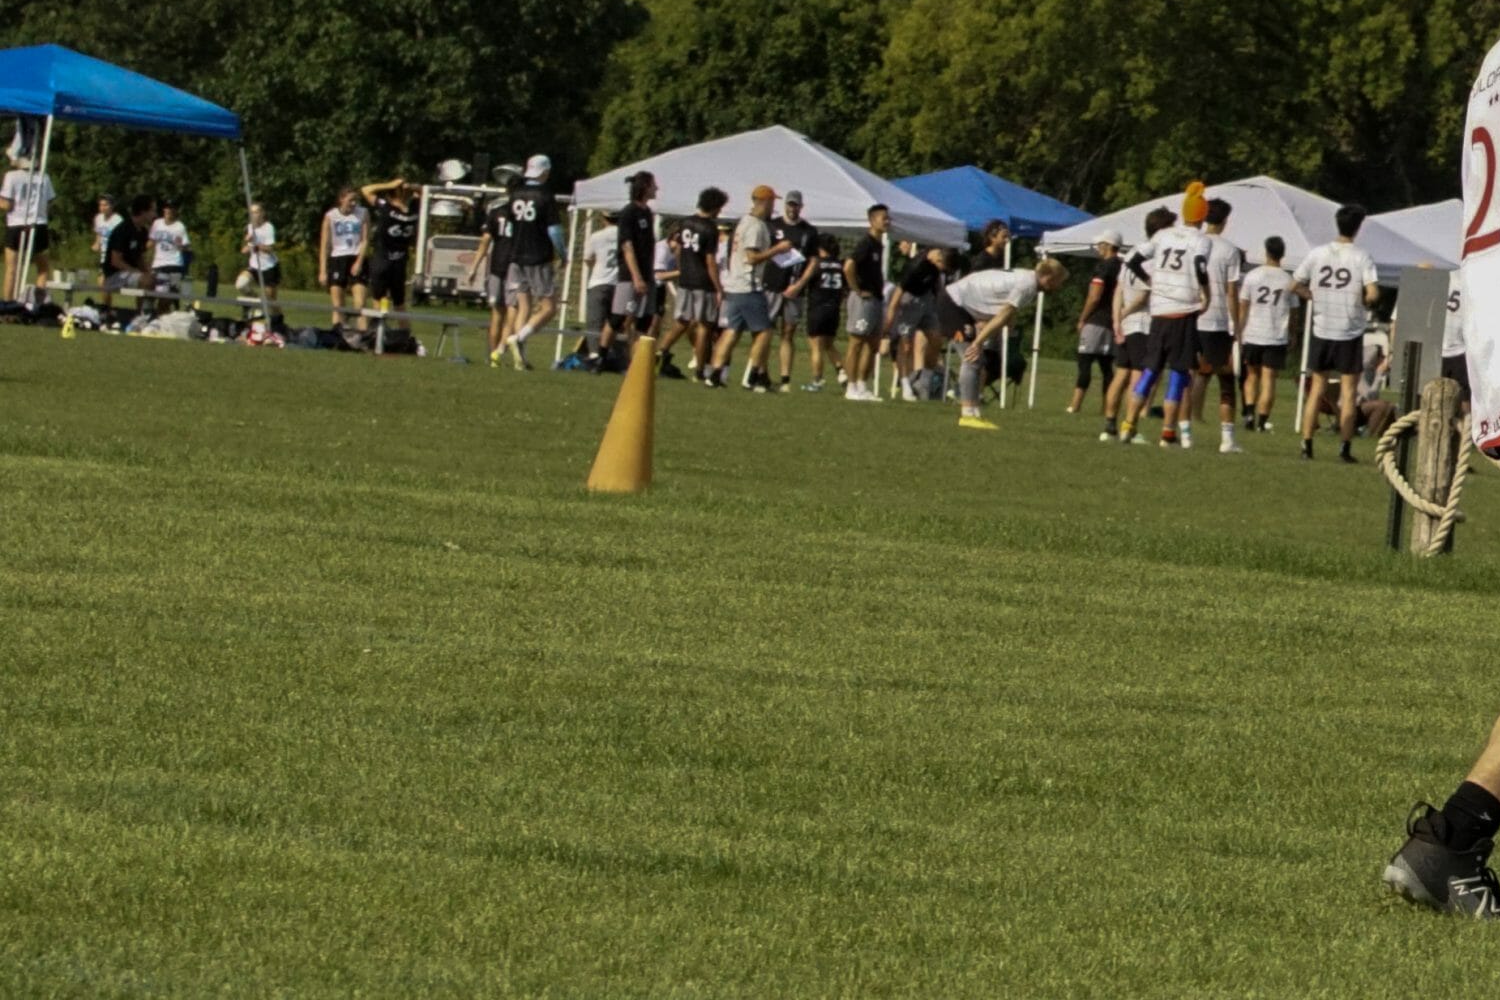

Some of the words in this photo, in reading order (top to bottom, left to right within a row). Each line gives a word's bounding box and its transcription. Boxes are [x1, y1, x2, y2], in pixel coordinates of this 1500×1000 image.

[512, 199, 536, 221] 96
[1160, 247, 1187, 271] 13
[820, 272, 843, 290] 25
[1318, 265, 1352, 289] 29
[1257, 286, 1283, 306] 21
